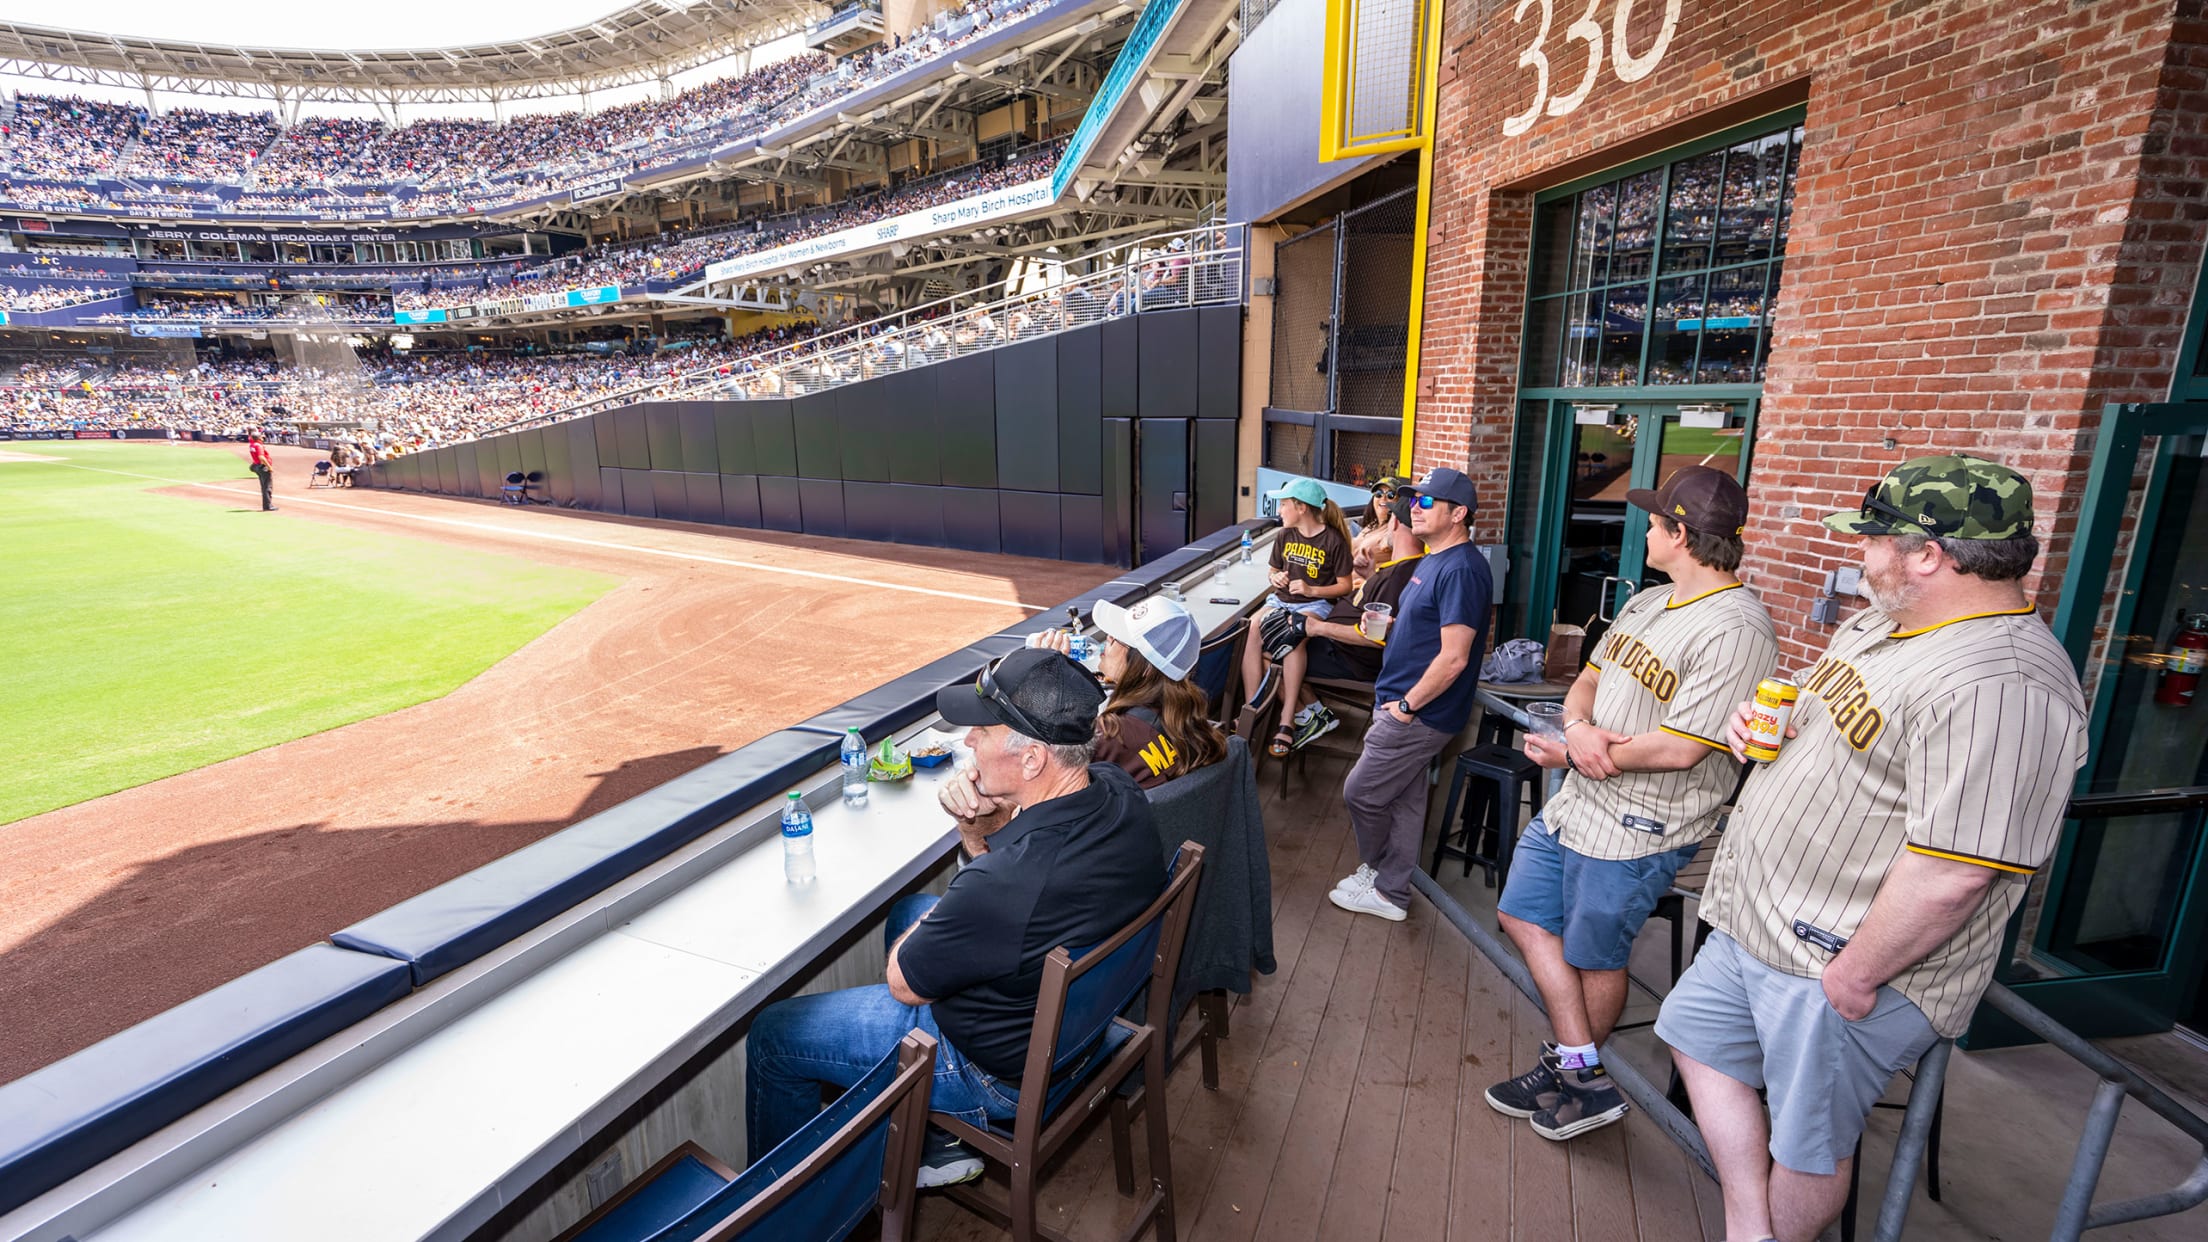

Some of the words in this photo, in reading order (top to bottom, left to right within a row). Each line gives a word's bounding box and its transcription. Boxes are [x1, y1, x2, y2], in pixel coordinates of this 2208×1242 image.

[1503, 0, 1682, 137] 330
[932, 209, 956, 225] Sharp
[958, 205, 979, 218] Mary
[982, 198, 1006, 213] Birch
[1008, 184, 1049, 206] Hospital
[147, 230, 193, 240] JERRY
[200, 231, 266, 242] COLEMAN
[271, 234, 347, 243] BROADCAST
[351, 233, 396, 242] CENTER
[876, 223, 899, 241] SHARP
[51, 257, 61, 266] C
[1283, 542, 1326, 565] PADRES
[786, 824, 809, 832] DASANI
